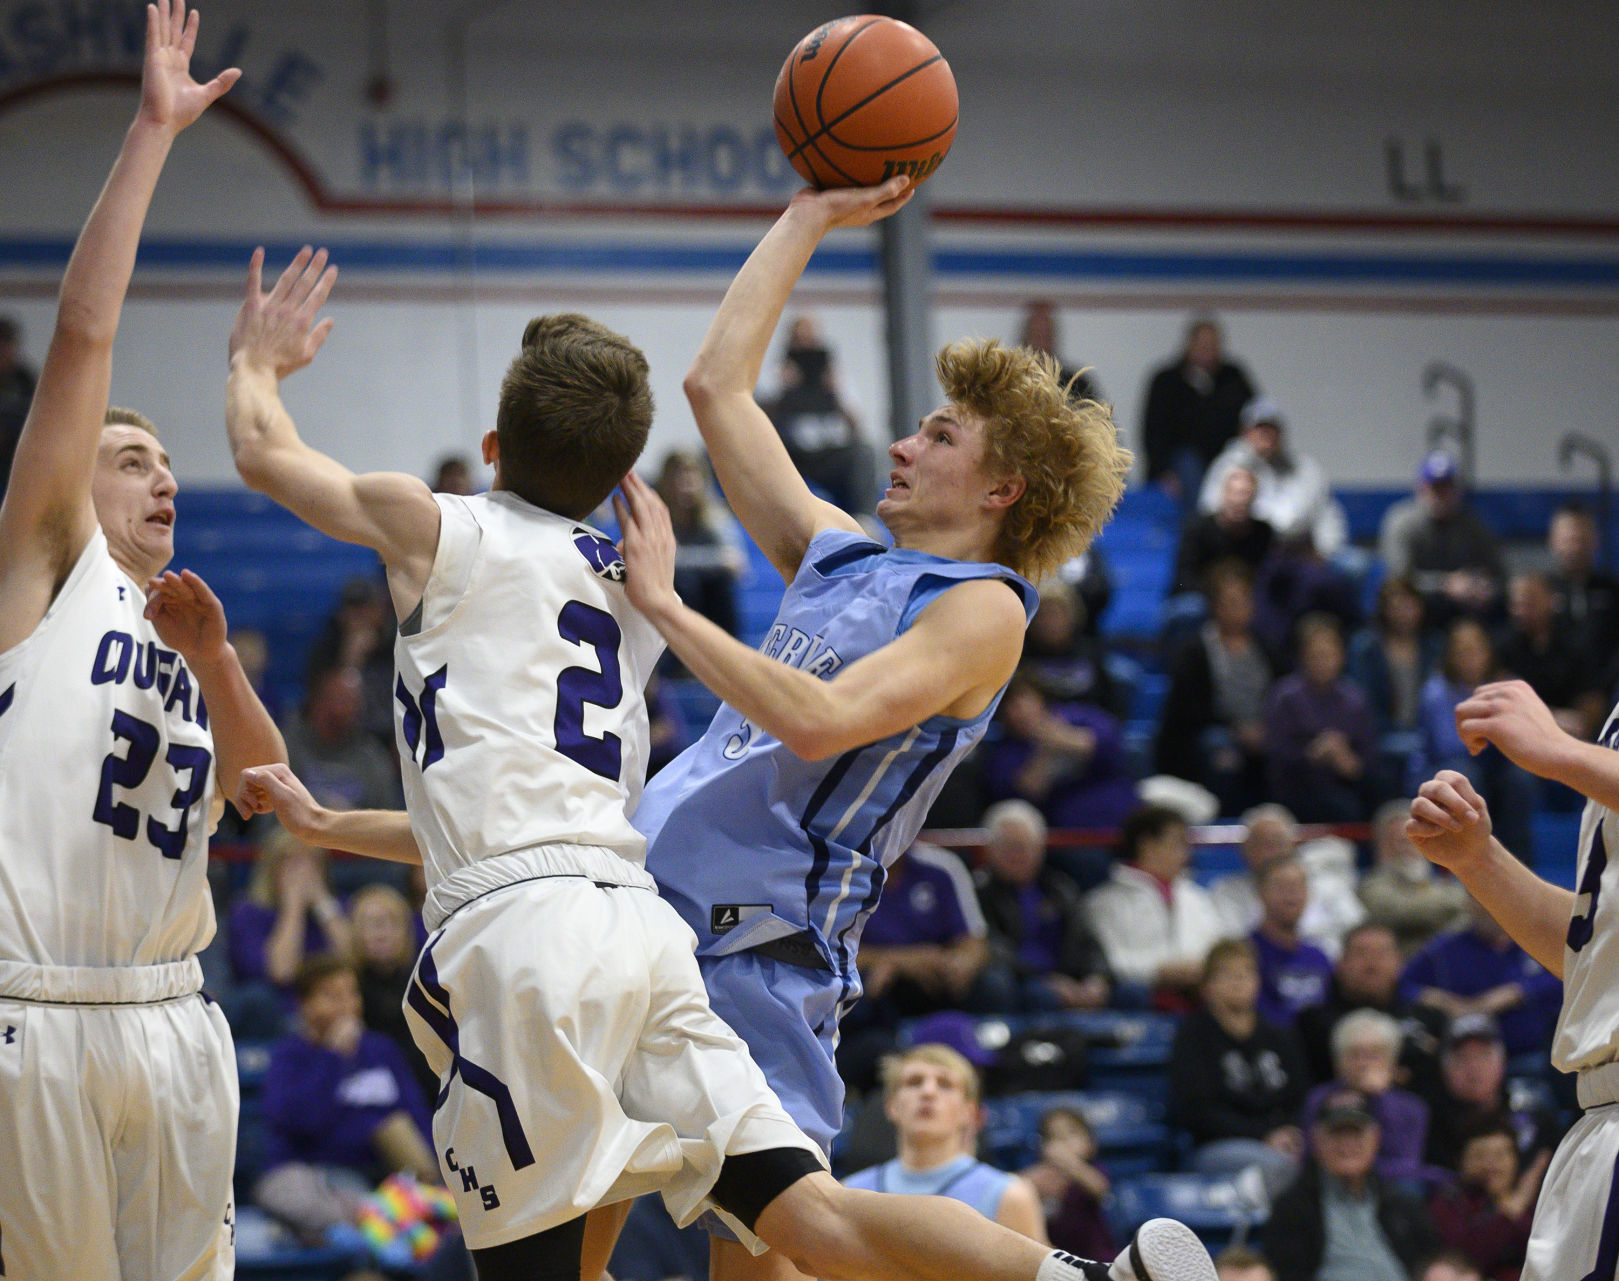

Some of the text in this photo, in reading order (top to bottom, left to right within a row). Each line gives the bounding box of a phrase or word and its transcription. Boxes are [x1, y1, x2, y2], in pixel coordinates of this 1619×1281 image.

[359, 120, 778, 192] HIGH SCHOO
[554, 599, 622, 782] 2
[92, 708, 211, 860] 23
[445, 1147, 501, 1211] CHS
